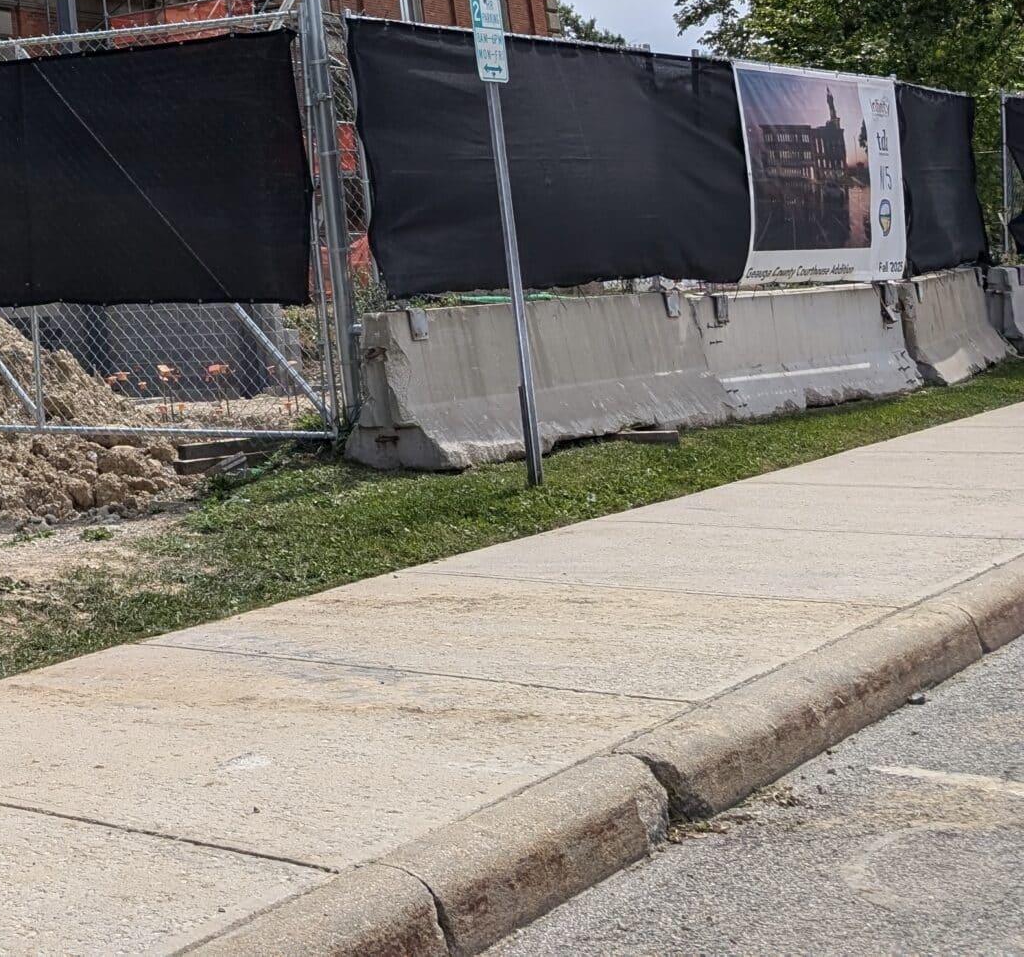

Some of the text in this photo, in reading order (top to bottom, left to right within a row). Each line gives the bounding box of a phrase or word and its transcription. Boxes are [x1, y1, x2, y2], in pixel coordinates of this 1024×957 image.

[473, 0, 481, 21] 2
[746, 263, 855, 281] Geauga County Courthouse Addition
[879, 261, 888, 273] Fall
